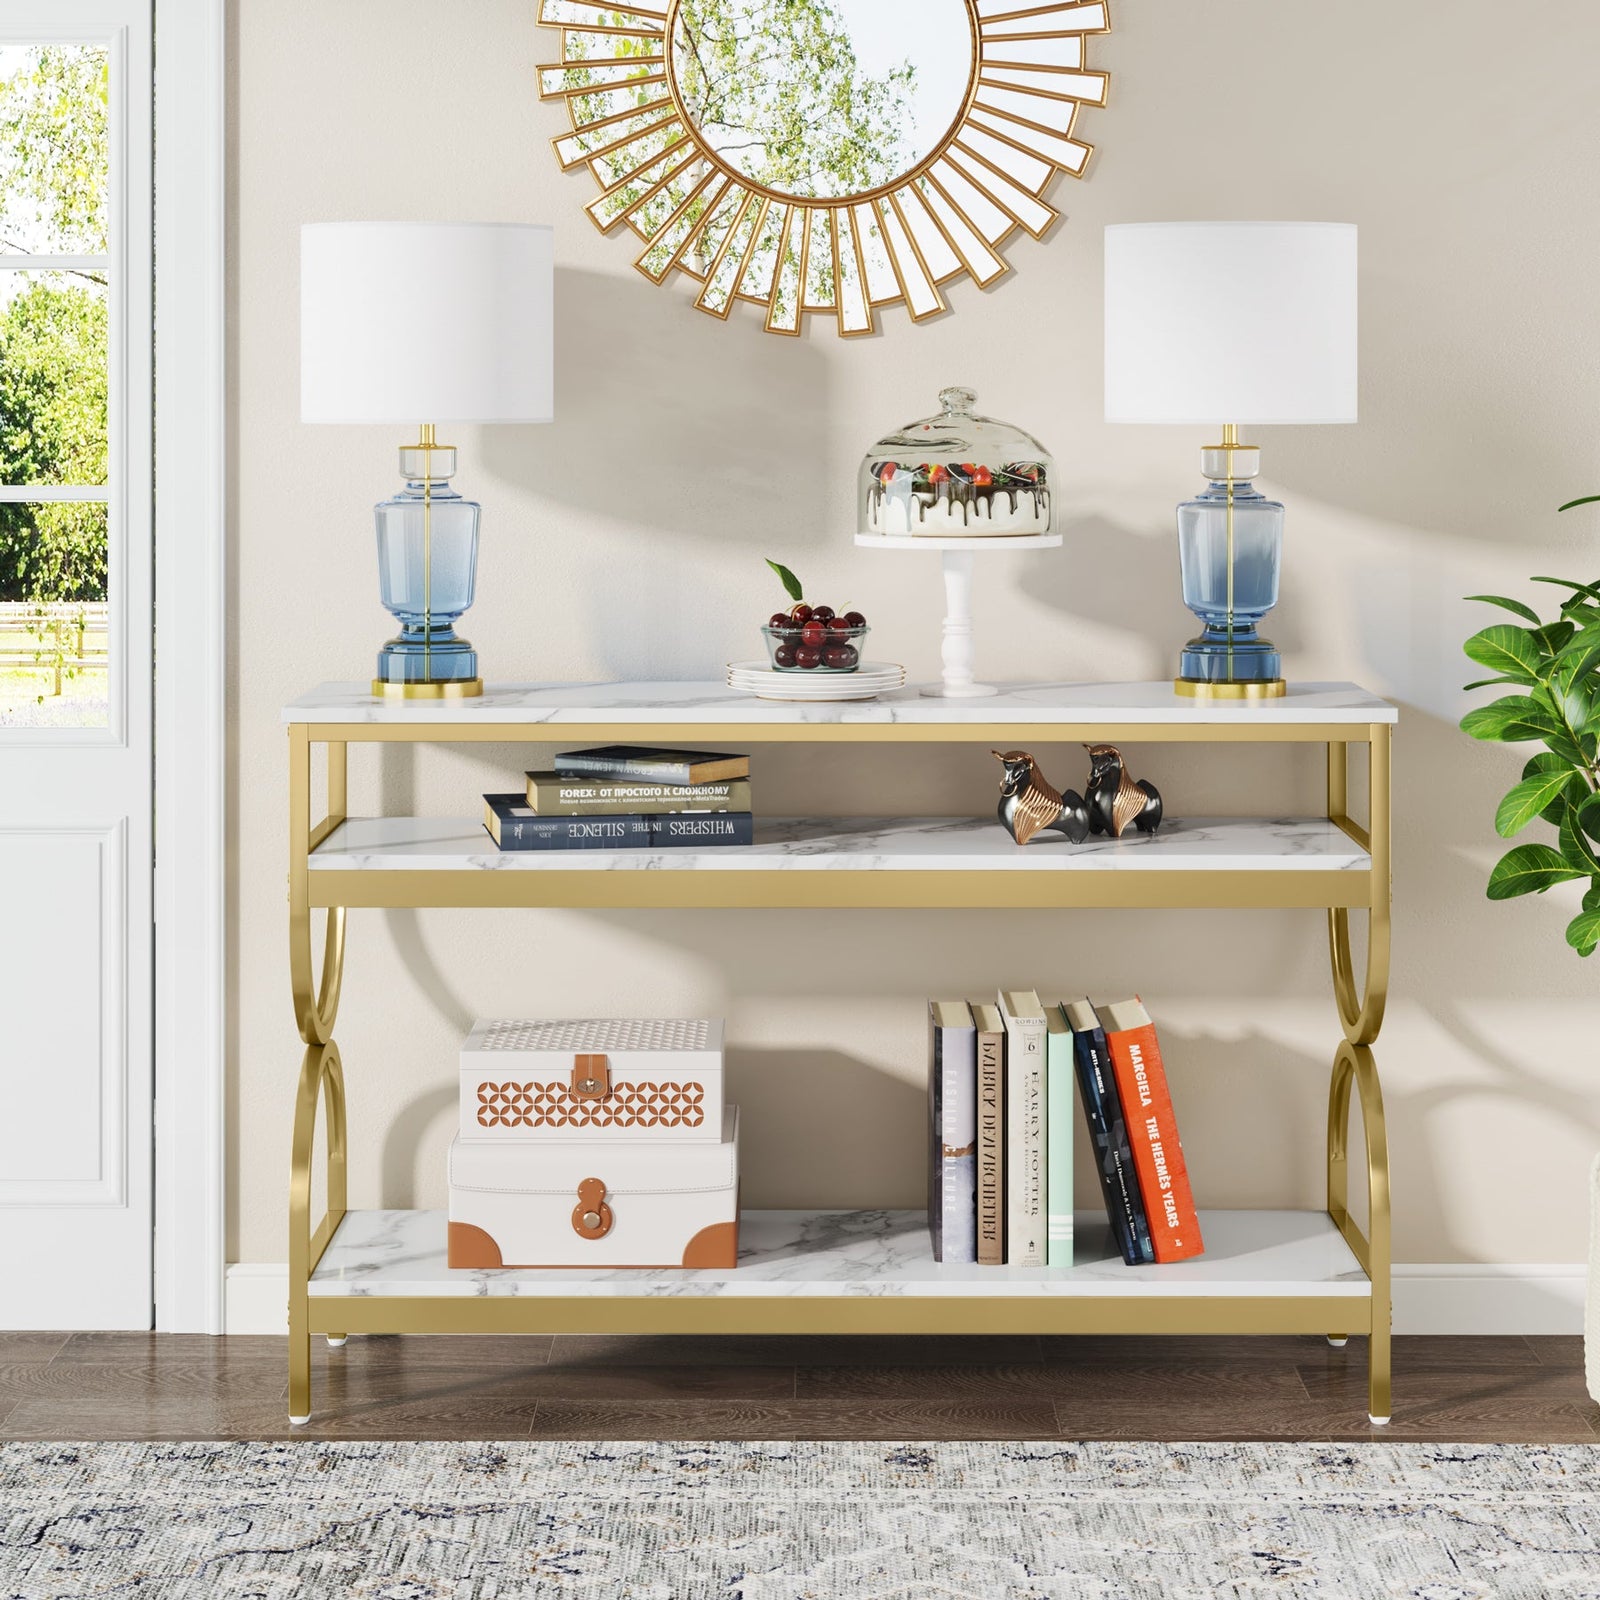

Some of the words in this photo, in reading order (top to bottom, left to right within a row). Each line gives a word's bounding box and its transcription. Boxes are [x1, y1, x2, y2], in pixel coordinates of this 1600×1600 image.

[560, 788, 597, 798] FOREX:
[600, 788, 612, 797] ОТ
[614, 787, 662, 797] ПРОСТОГО
[672, 786, 729, 796] СЛОЖНОМУ
[568, 822, 625, 837] SILENCE
[632, 822, 650, 832] THE
[652, 822, 662, 832] IN
[669, 820, 735, 835] WHISPERS
[1028, 1042, 1036, 1052] 6
[1129, 1044, 1152, 1106] MARGIELA
[944, 1070, 957, 1135] FASHION
[1032, 1072, 1040, 1140] HARRY
[1146, 1117, 1160, 1140] THE
[944, 1145, 957, 1212] CULTURE
[1152, 1142, 1172, 1189] HERMÈS
[1032, 1150, 1040, 1216] POTTER
[1162, 1192, 1180, 1228] YEARS
